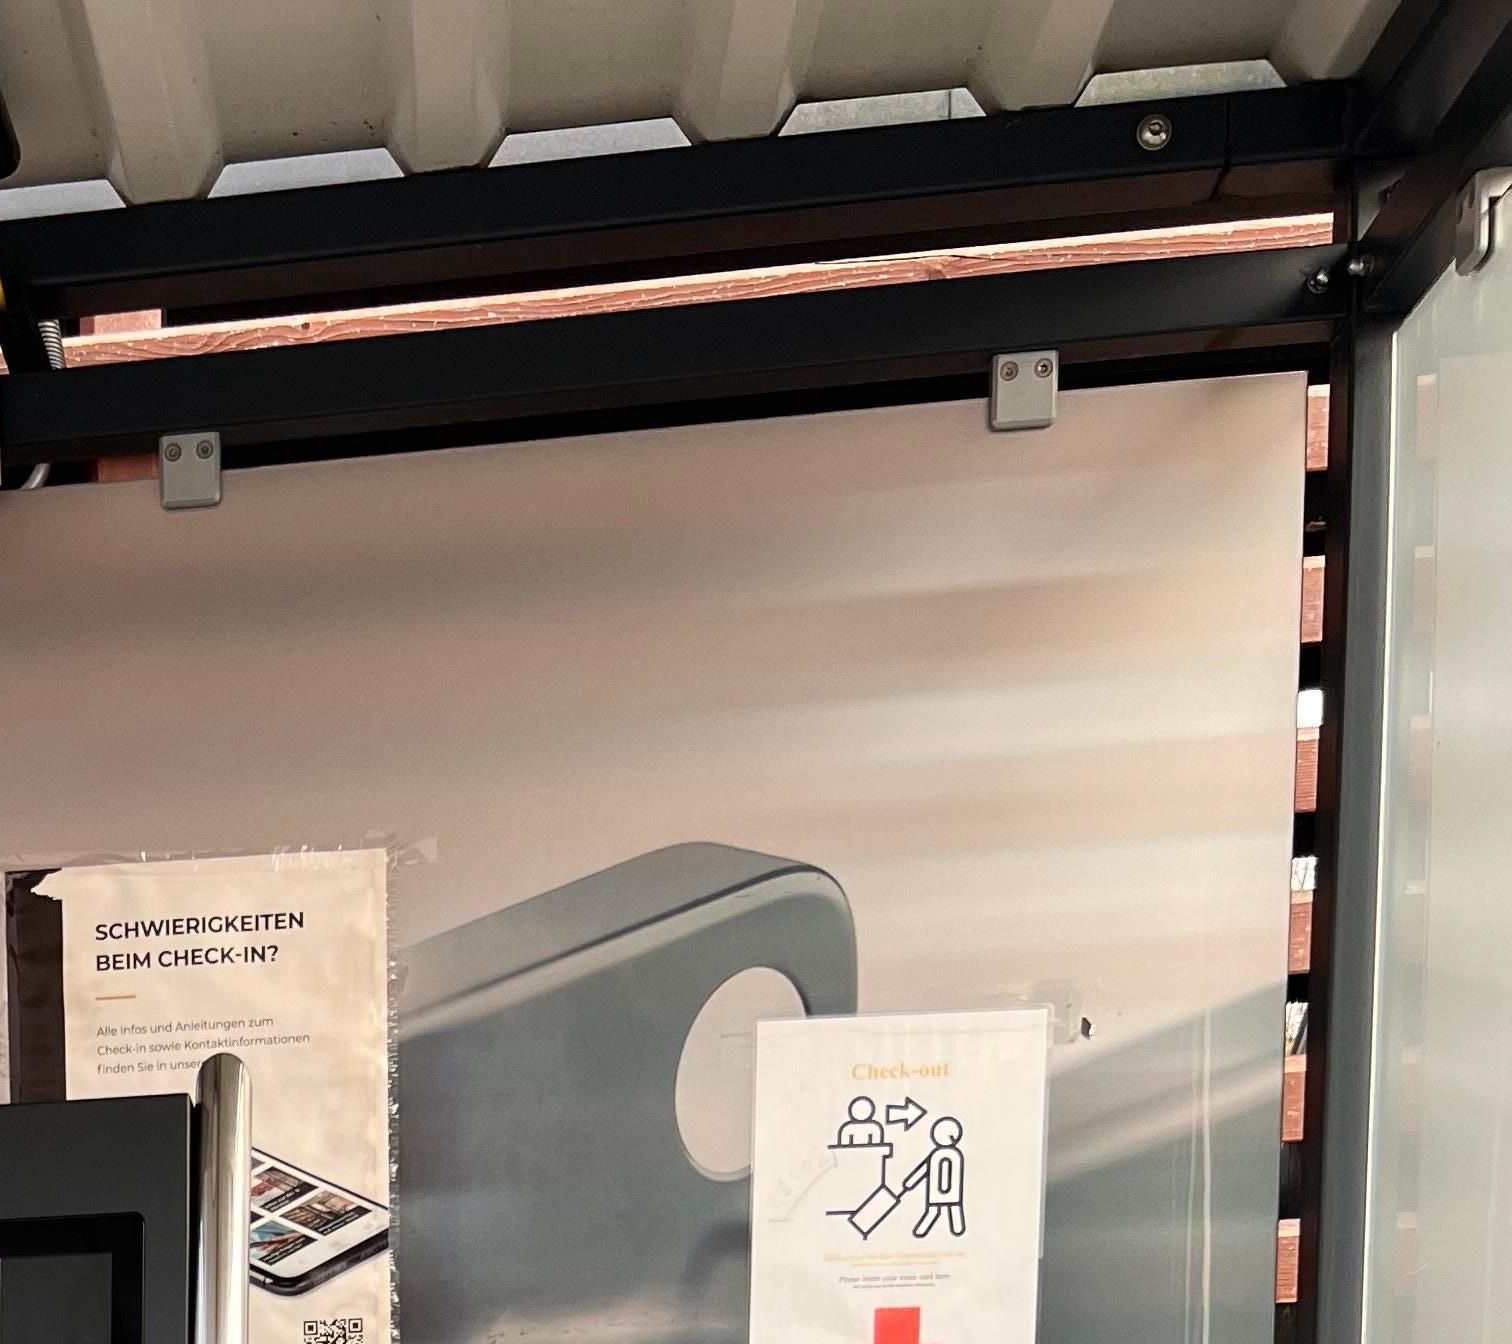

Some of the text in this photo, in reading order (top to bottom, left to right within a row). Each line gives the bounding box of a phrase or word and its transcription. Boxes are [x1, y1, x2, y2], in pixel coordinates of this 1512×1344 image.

[95, 911, 304, 941] SCHWIERIGKEITEN
[96, 945, 279, 972] BEIM CHECK-IN?
[96, 1018, 274, 1037] Alle Infos und Anleitungen zum
[97, 1033, 310, 1056] Check-in sowie Kontaktinformationen
[97, 1060, 202, 1075] finden Sie in unser
[852, 1062, 949, 1081] Check-out
